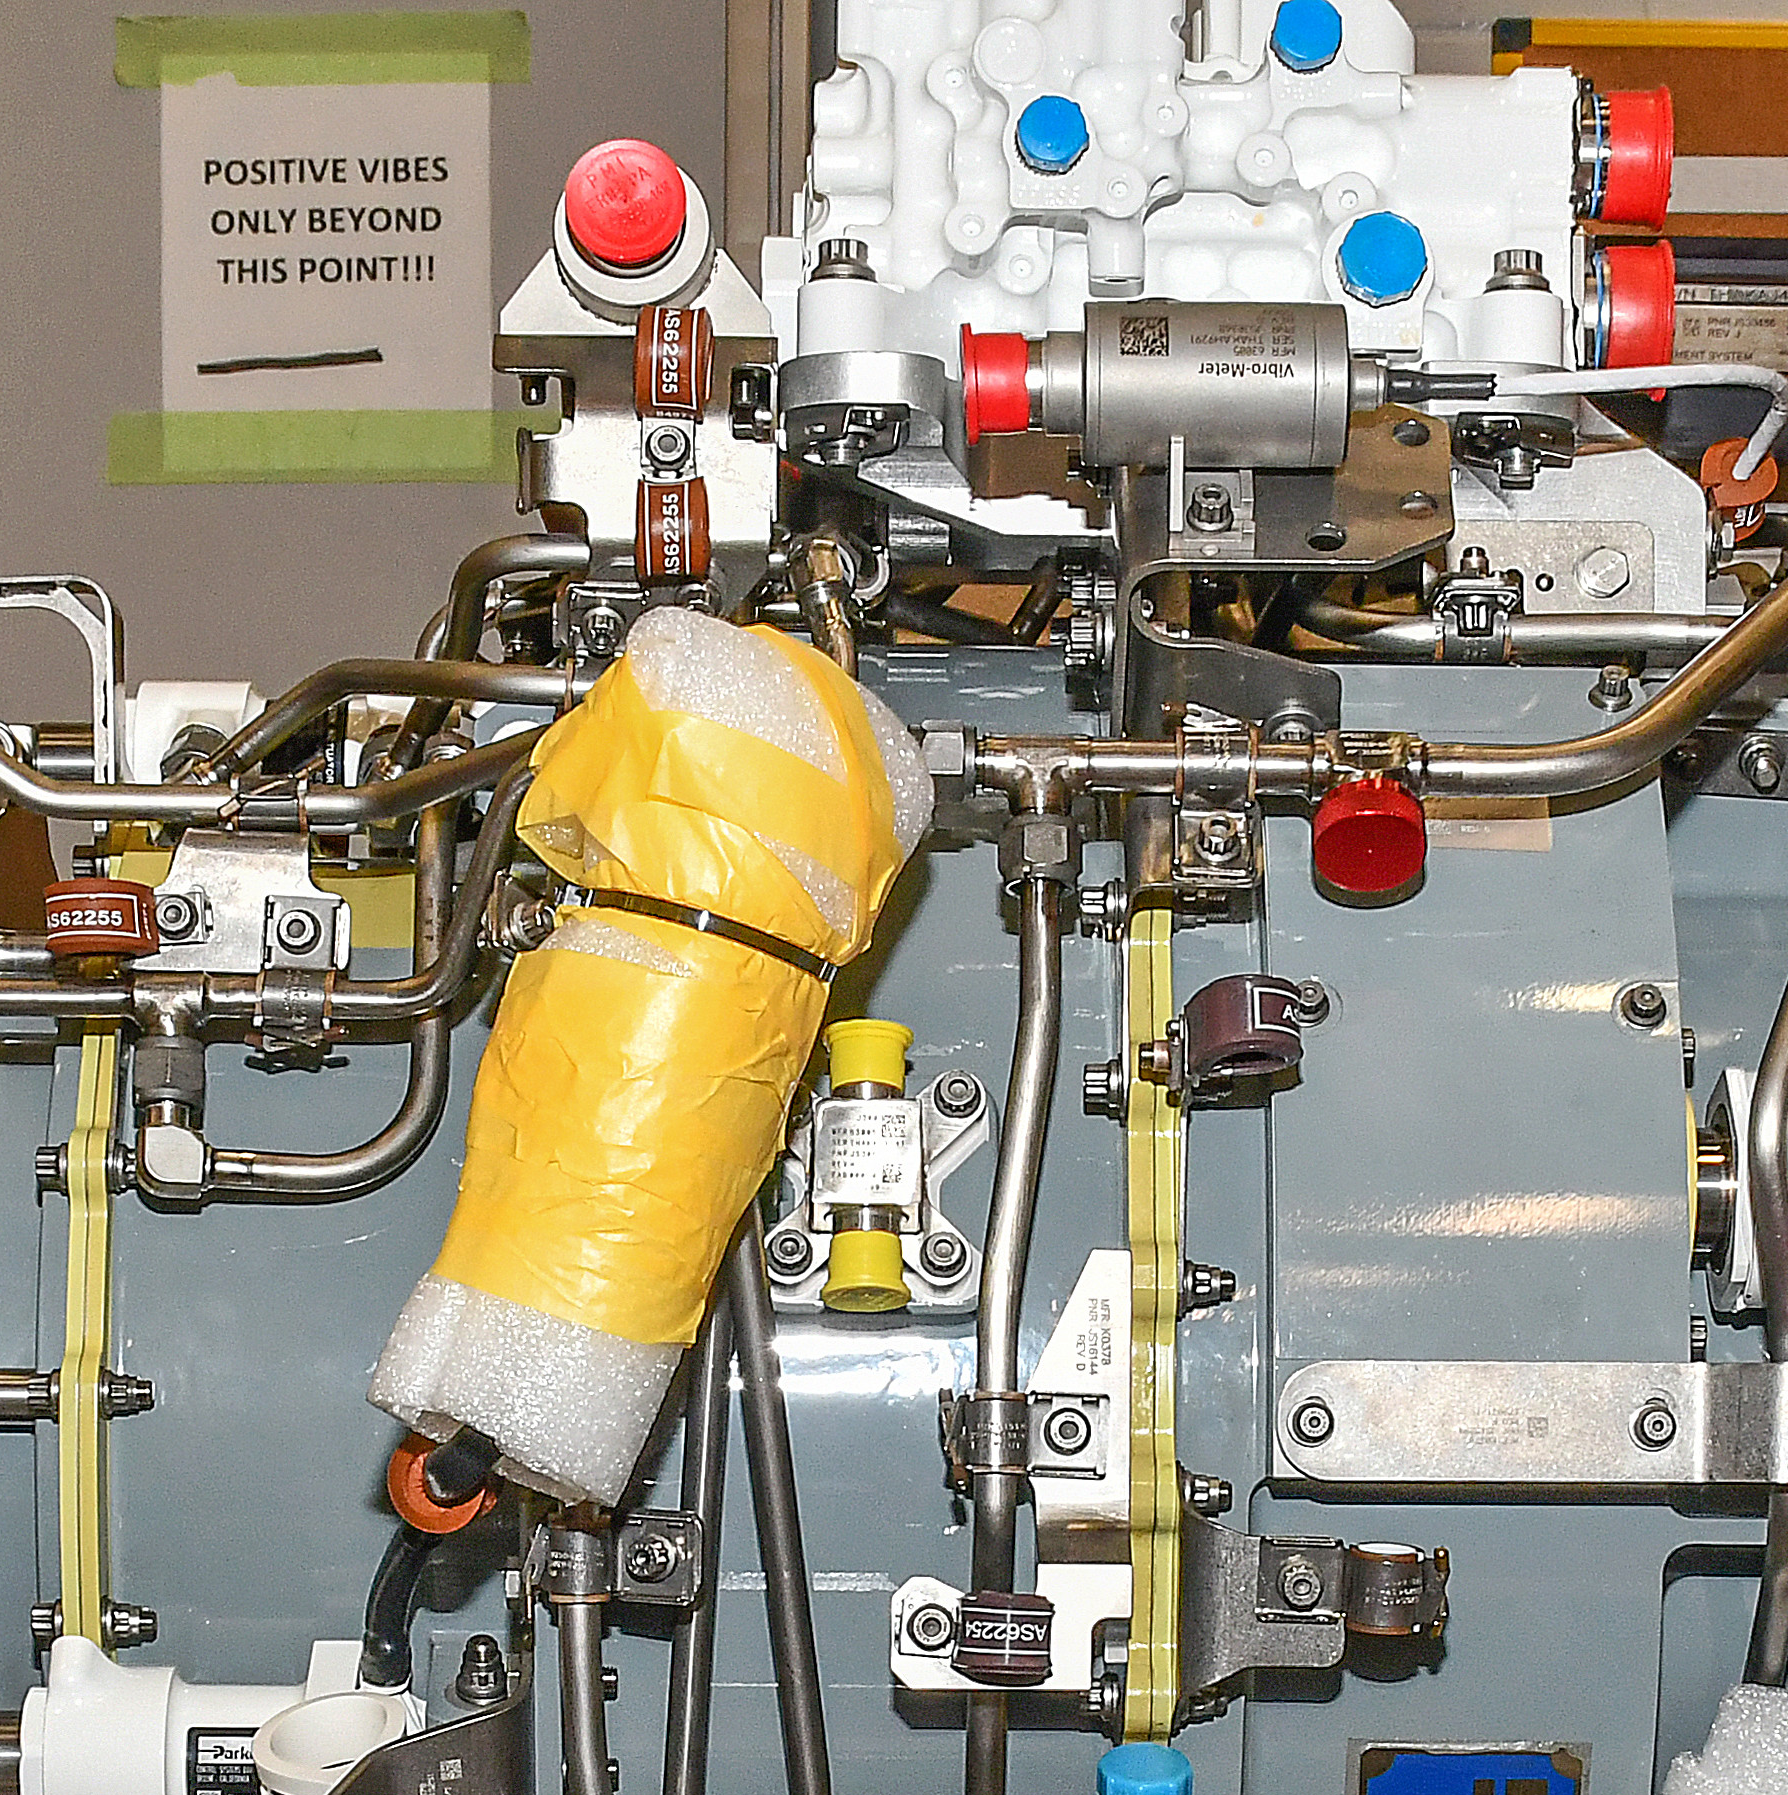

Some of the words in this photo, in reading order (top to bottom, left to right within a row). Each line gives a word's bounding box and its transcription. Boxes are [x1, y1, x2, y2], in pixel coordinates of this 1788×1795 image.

[203, 158, 347, 186] POSITIVE
[358, 156, 449, 184] VIBES
[211, 208, 297, 235] ONLY
[308, 207, 442, 234] BEYOND
[217, 257, 288, 285] THIS
[299, 256, 434, 283] POINT!!!
[662, 309, 681, 394] AS62255
[1197, 362, 1295, 379] Vibro-Meter
[662, 493, 681, 576] AS62255
[1088, 1298, 1098, 1322] PNR
[1076, 1334, 1086, 1358] REV
[1076, 1363, 1086, 1371] D
[965, 1620, 1048, 1642] AS62254
[212, 1745, 253, 1760] Park
